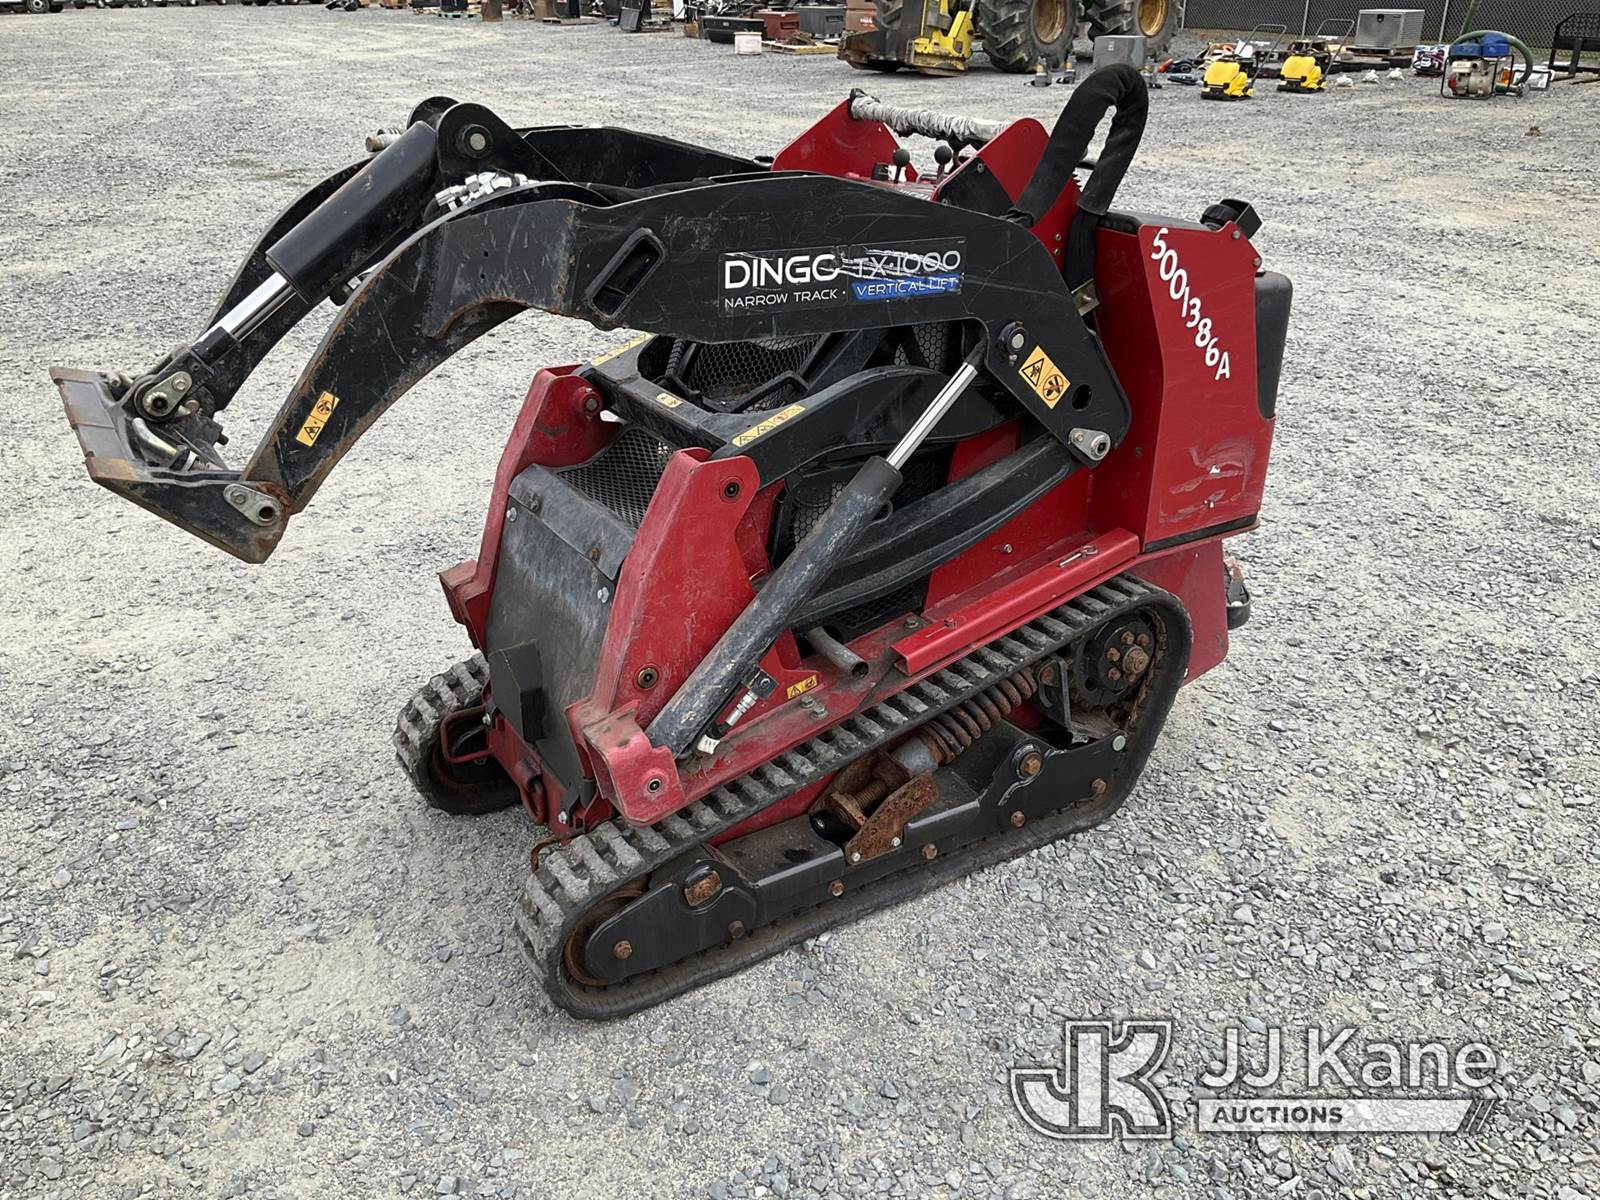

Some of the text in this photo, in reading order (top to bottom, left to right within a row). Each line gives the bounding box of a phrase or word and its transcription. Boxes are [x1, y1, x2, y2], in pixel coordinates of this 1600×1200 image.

[724, 253, 841, 289] DINGO
[724, 277, 958, 308] NARROW TRACK VERTICAL LIFT
[1151, 228, 1230, 380] 5001386A
